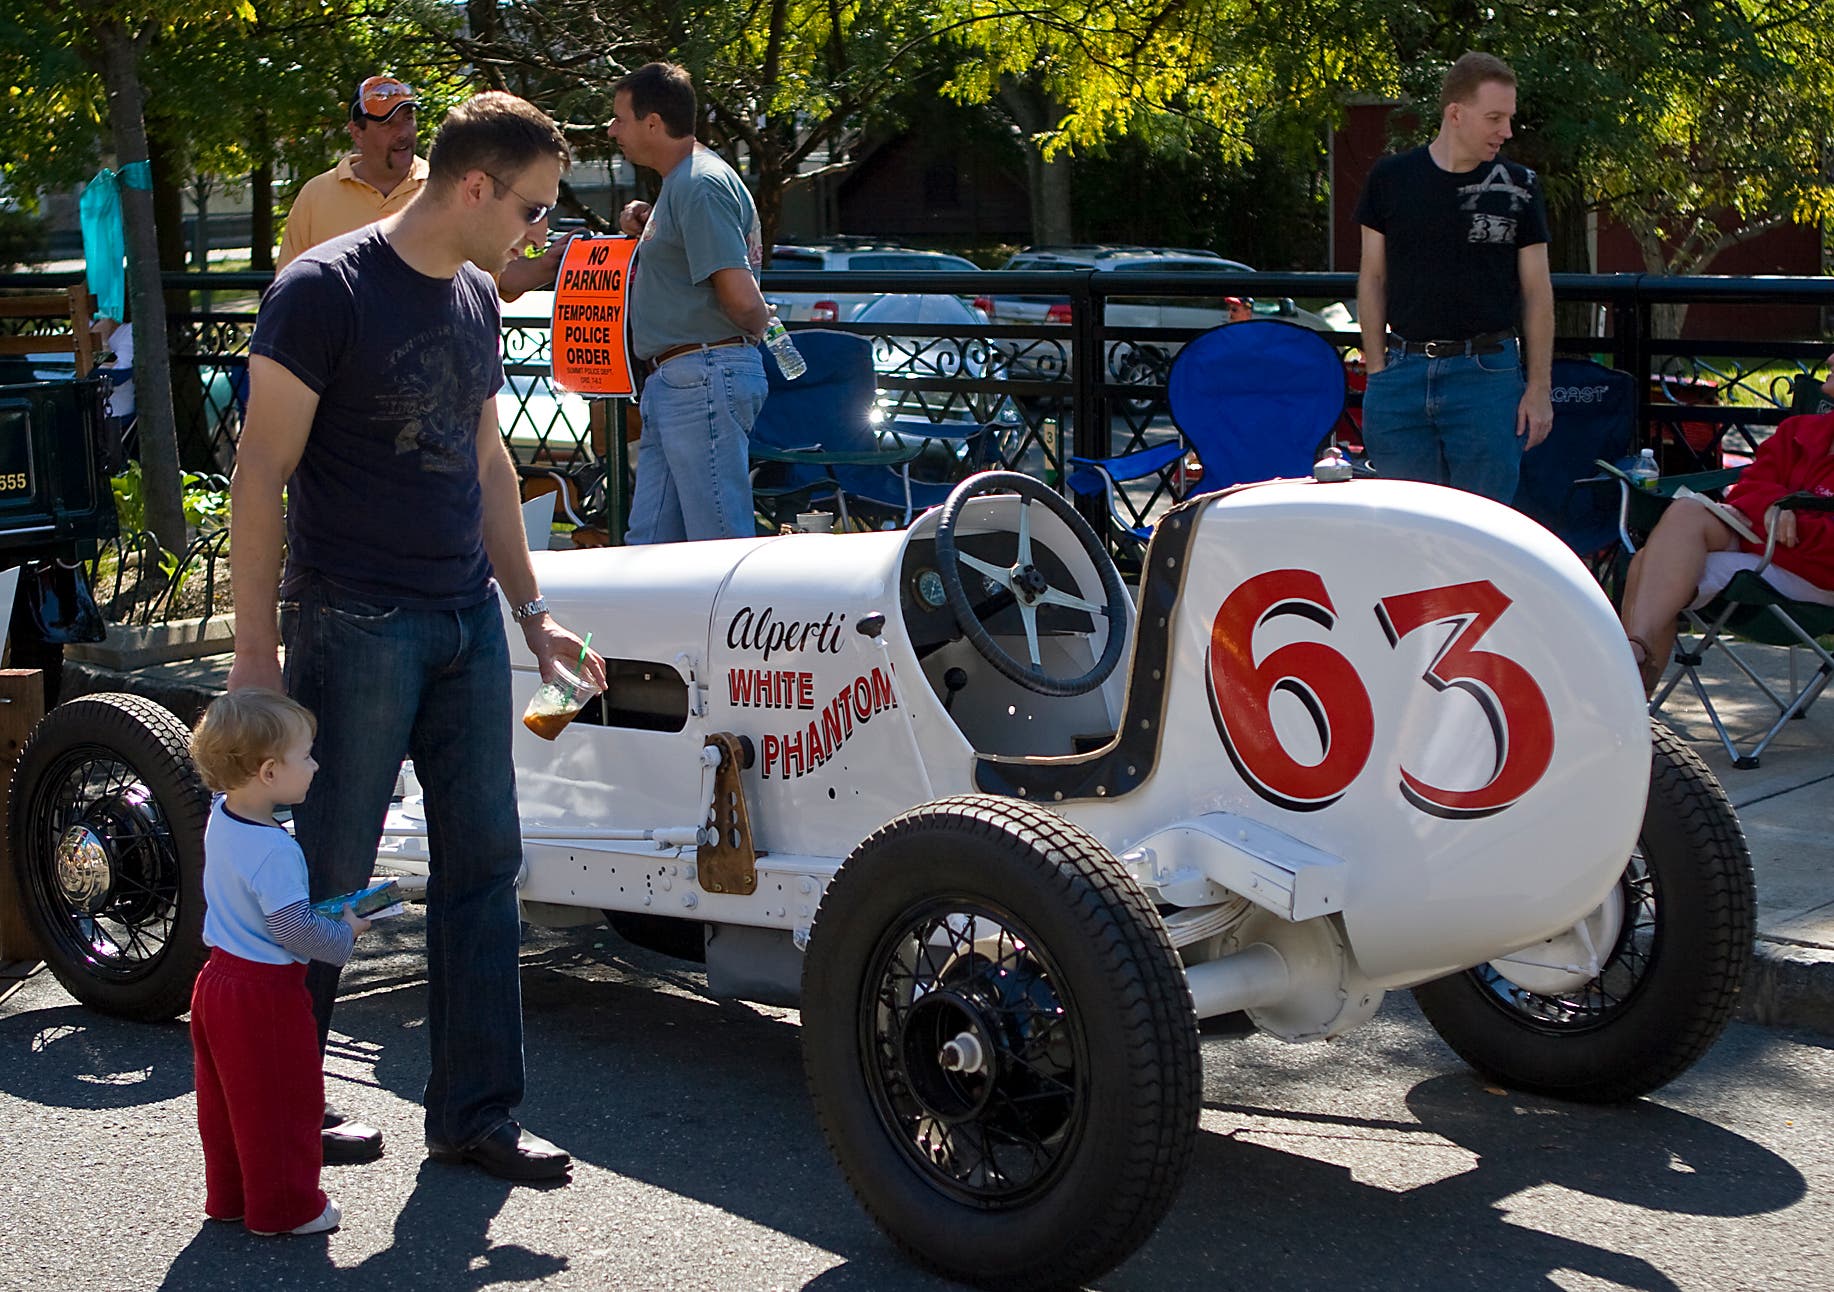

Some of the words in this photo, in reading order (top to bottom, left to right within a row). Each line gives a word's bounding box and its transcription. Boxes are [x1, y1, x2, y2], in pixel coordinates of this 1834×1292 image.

[587, 246, 609, 266] NO
[563, 270, 621, 291] PARKING
[558, 304, 621, 322] TEMPORARY
[565, 326, 610, 344] POLICE
[566, 348, 611, 365] ORDER
[584, 367, 600, 376] POLICE
[727, 606, 846, 662] Alperti
[728, 668, 815, 710] WHITE
[1205, 568, 1555, 820] 63
[761, 662, 899, 780] PHANTOM
